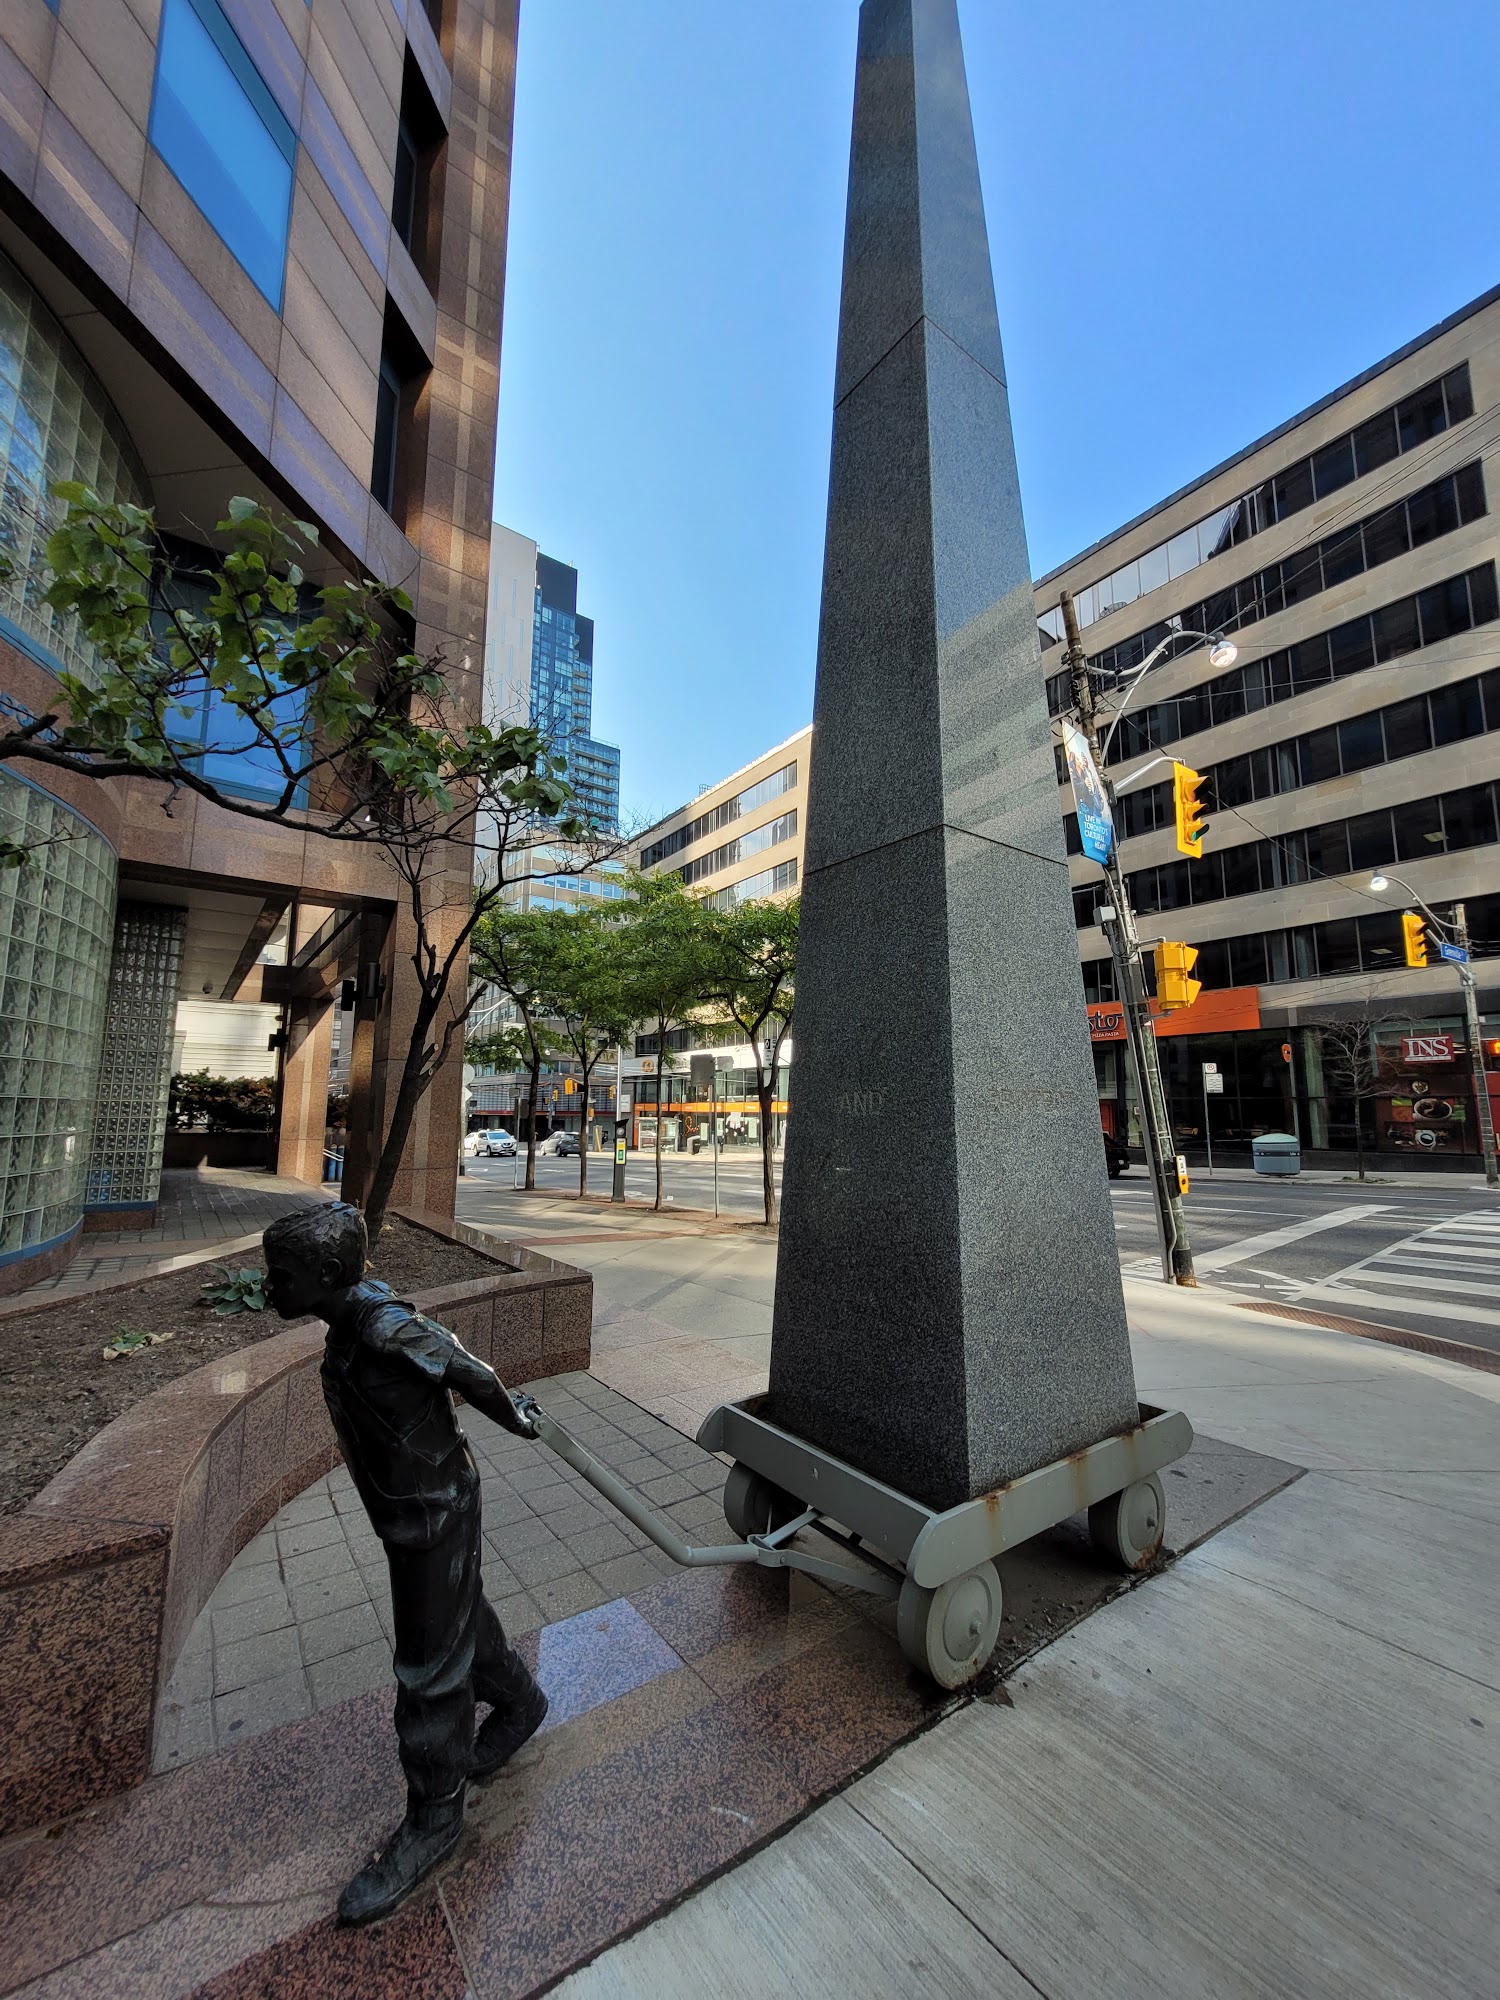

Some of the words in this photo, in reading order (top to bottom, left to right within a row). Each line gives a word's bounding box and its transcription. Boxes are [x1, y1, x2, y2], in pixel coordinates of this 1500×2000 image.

[1085, 814, 1096, 823] LIVE
[1084, 830, 1105, 843] CULTURAL
[1095, 840, 1107, 851] HEART
[1406, 1038, 1450, 1057] INS
